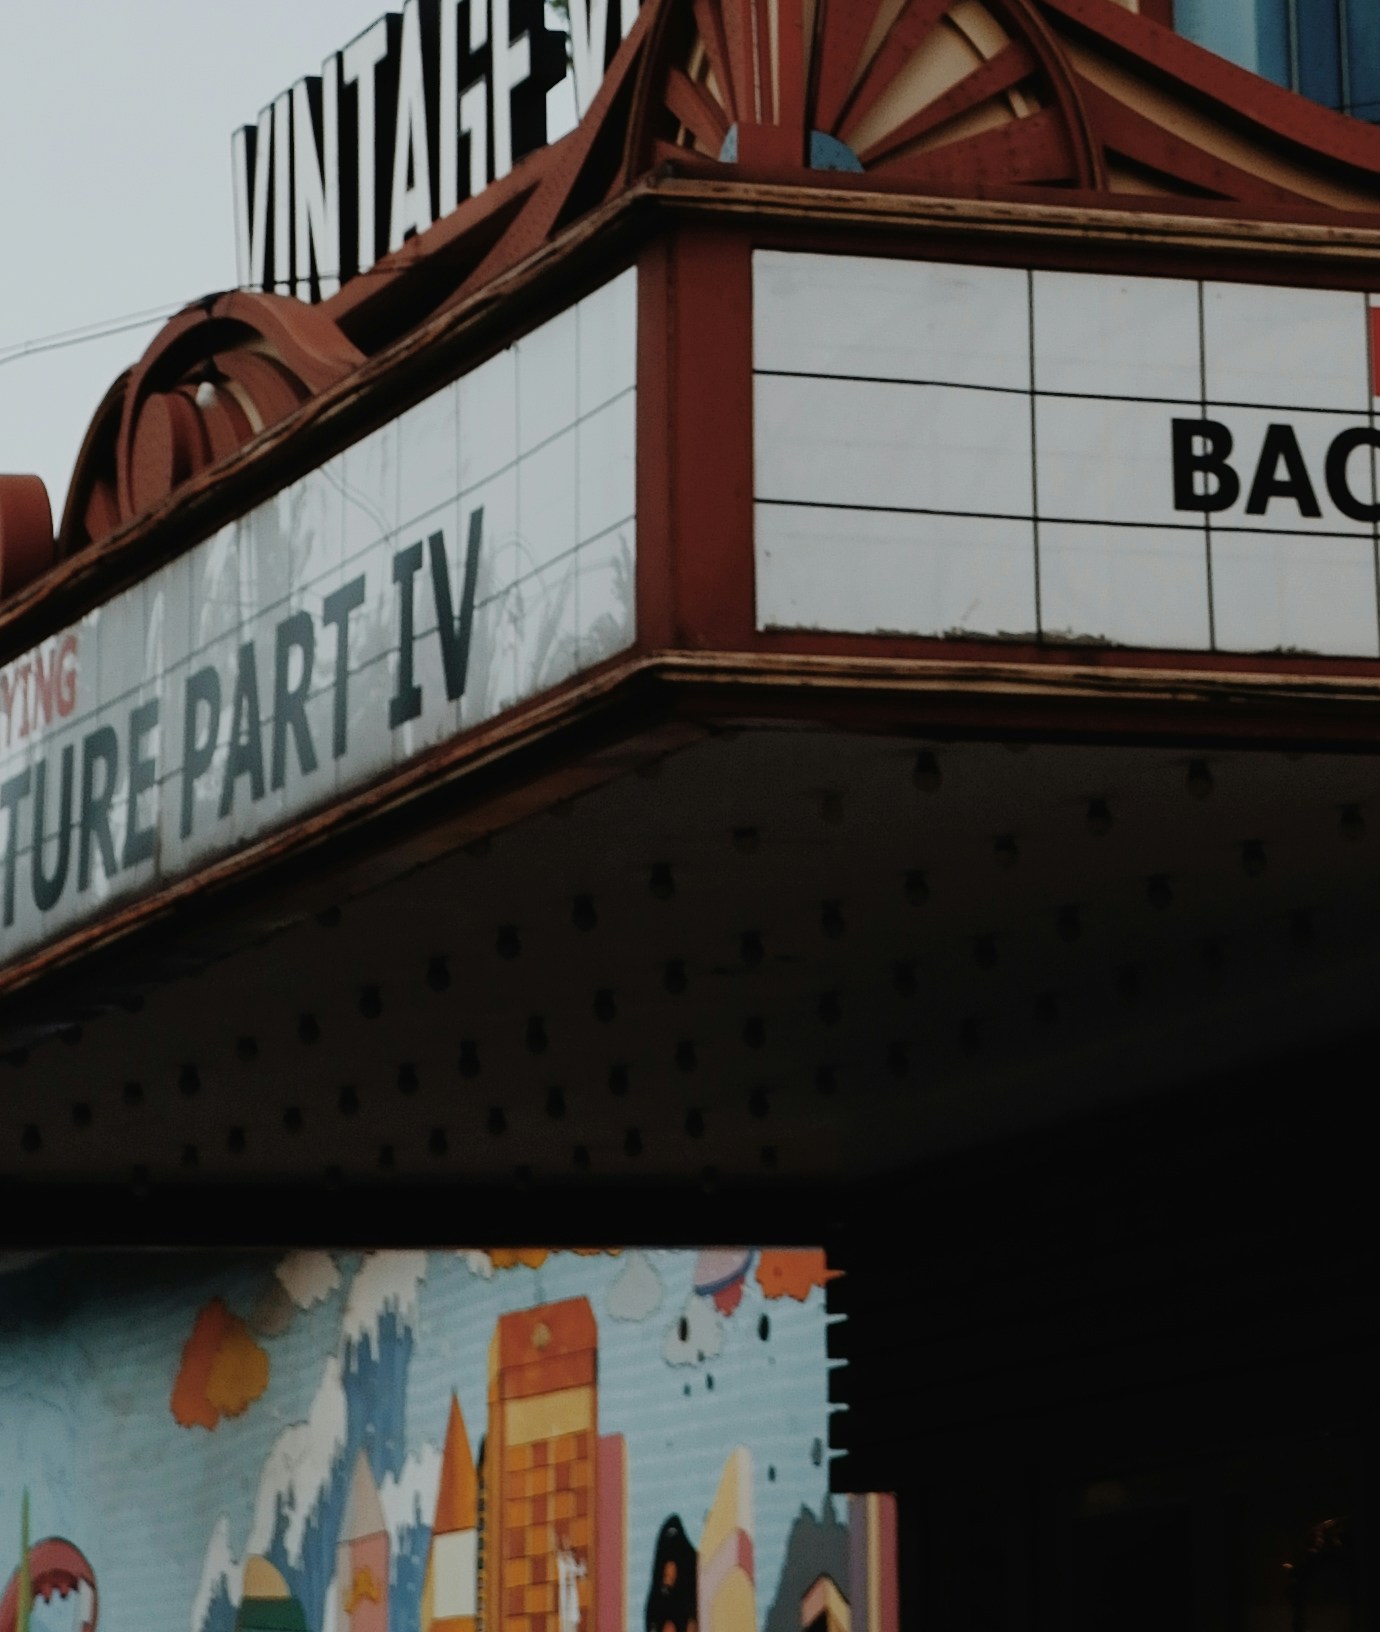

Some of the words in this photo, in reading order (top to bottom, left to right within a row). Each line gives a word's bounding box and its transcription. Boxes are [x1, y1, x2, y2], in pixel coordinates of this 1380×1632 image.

[0, 698, 160, 928] TURE
[180, 572, 367, 841] PART
[387, 504, 486, 732] IV
